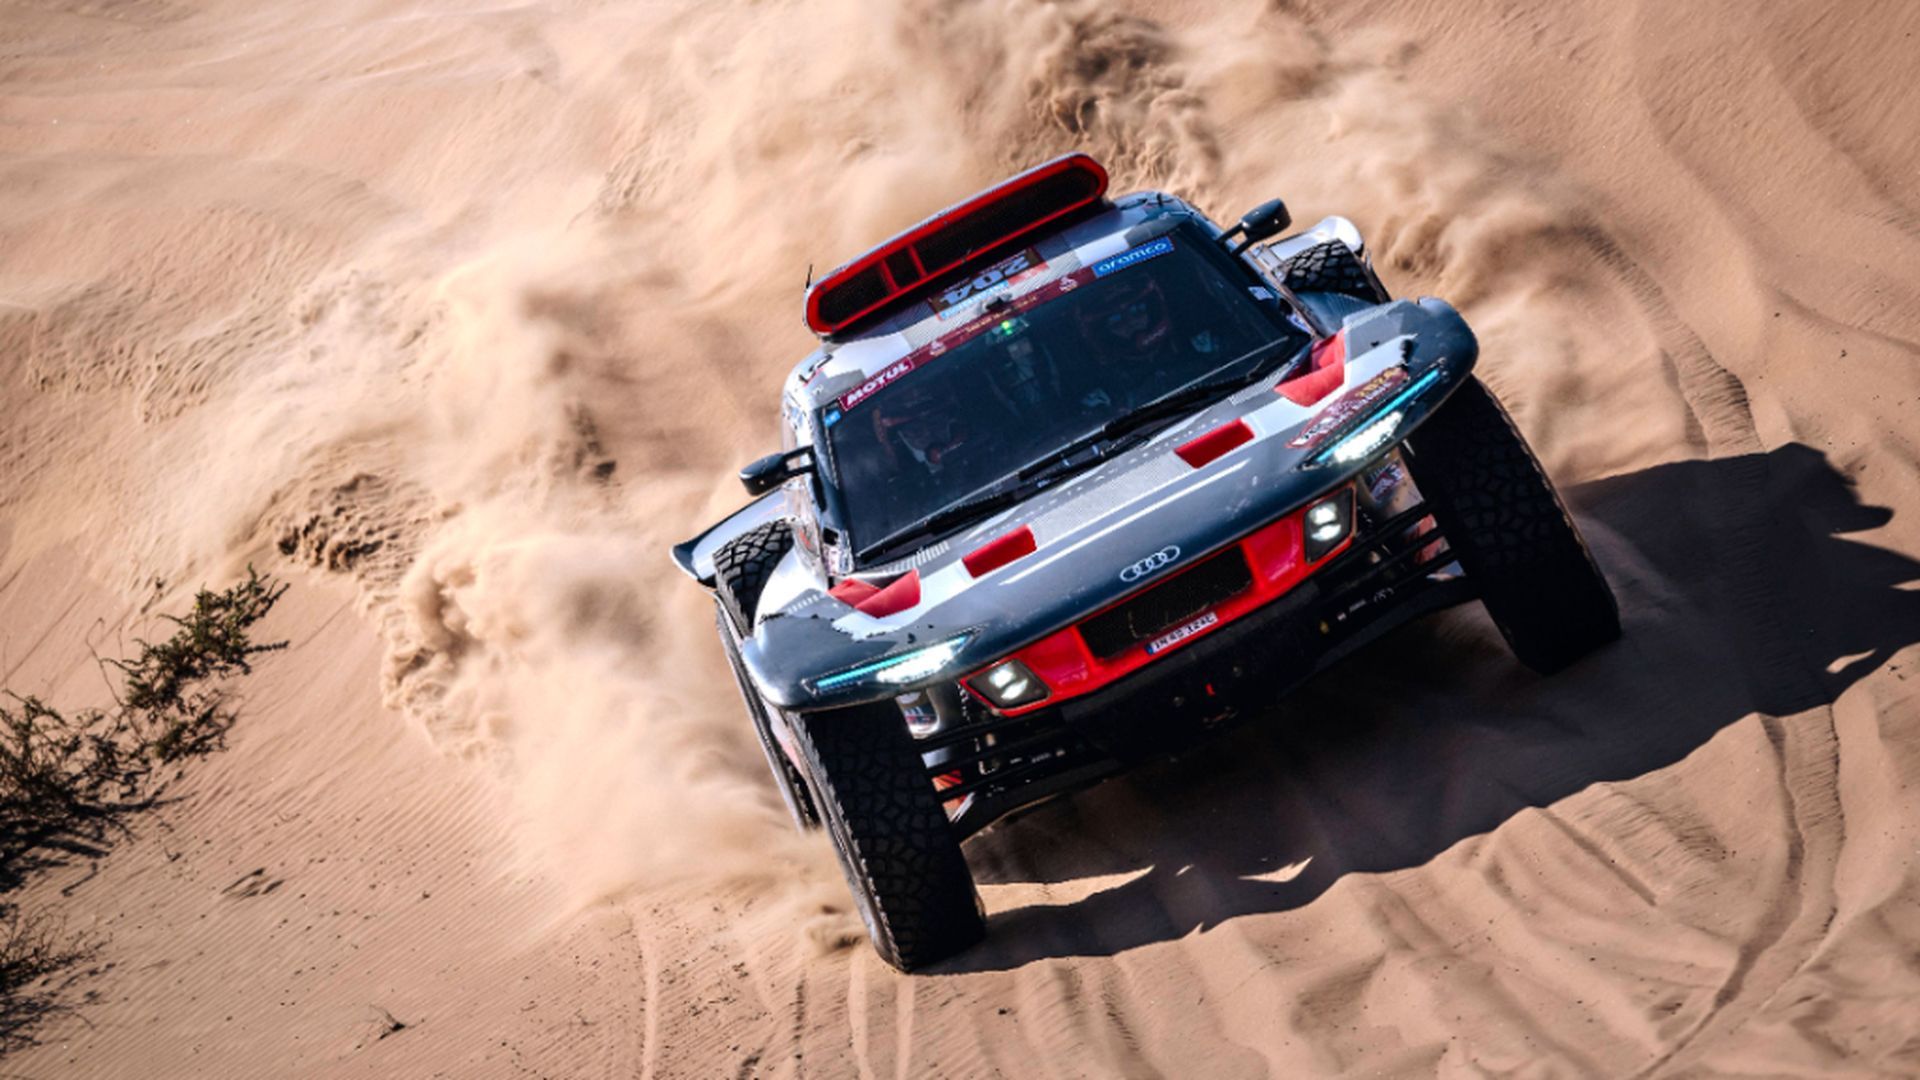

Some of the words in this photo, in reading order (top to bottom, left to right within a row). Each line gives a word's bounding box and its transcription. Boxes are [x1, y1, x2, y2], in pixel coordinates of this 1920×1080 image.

[941, 256, 1030, 305] 204
[1098, 242, 1168, 273] aramco
[846, 361, 911, 407] MOTUL
